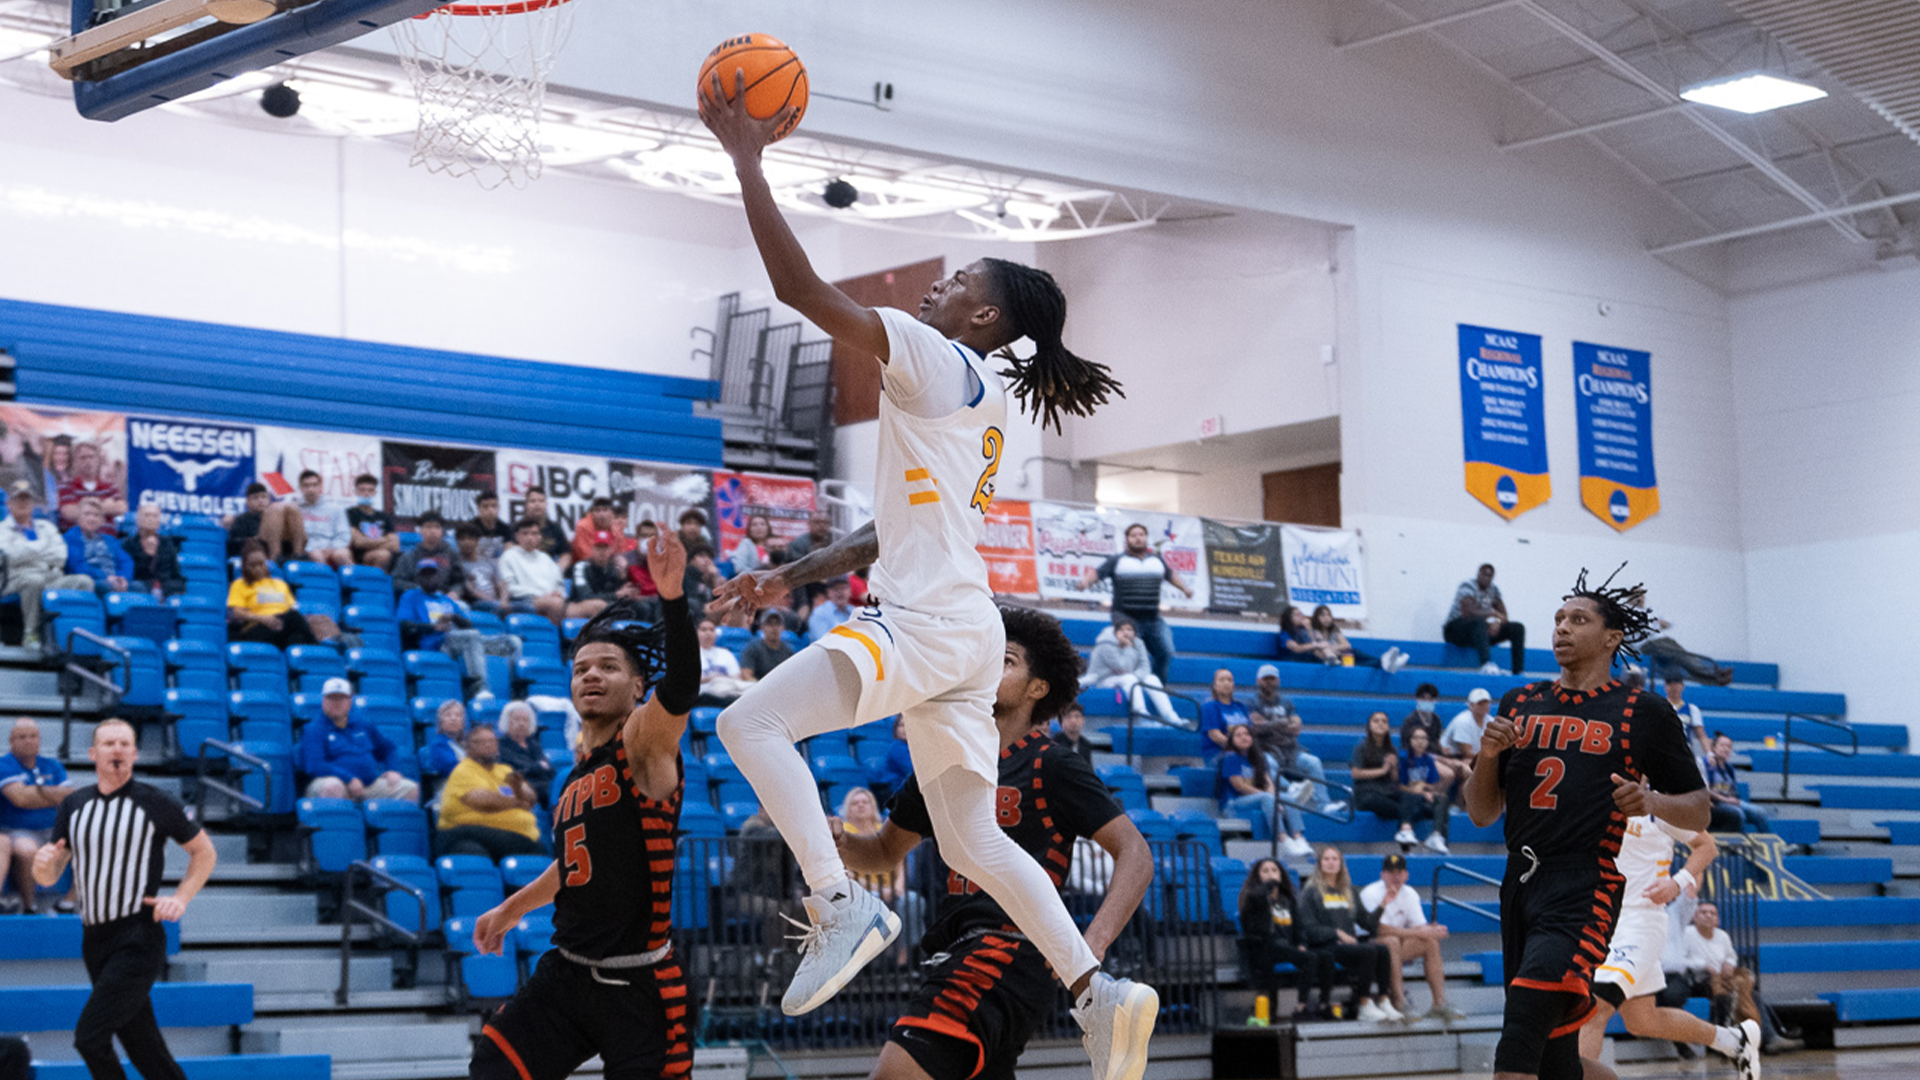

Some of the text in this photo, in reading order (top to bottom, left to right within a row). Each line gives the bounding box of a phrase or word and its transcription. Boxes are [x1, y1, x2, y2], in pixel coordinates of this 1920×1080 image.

[1466, 357, 1538, 389] CHAMPIONS
[1578, 373, 1648, 404] CHAMPIONS
[131, 421, 252, 457] NEESSEN
[139, 489, 247, 515] CHEVROLET
[393, 483, 482, 521] SMOKEHOUS
[1514, 714, 1613, 755] UTPB
[1530, 756, 1565, 810] 2
[564, 822, 593, 887] 5
